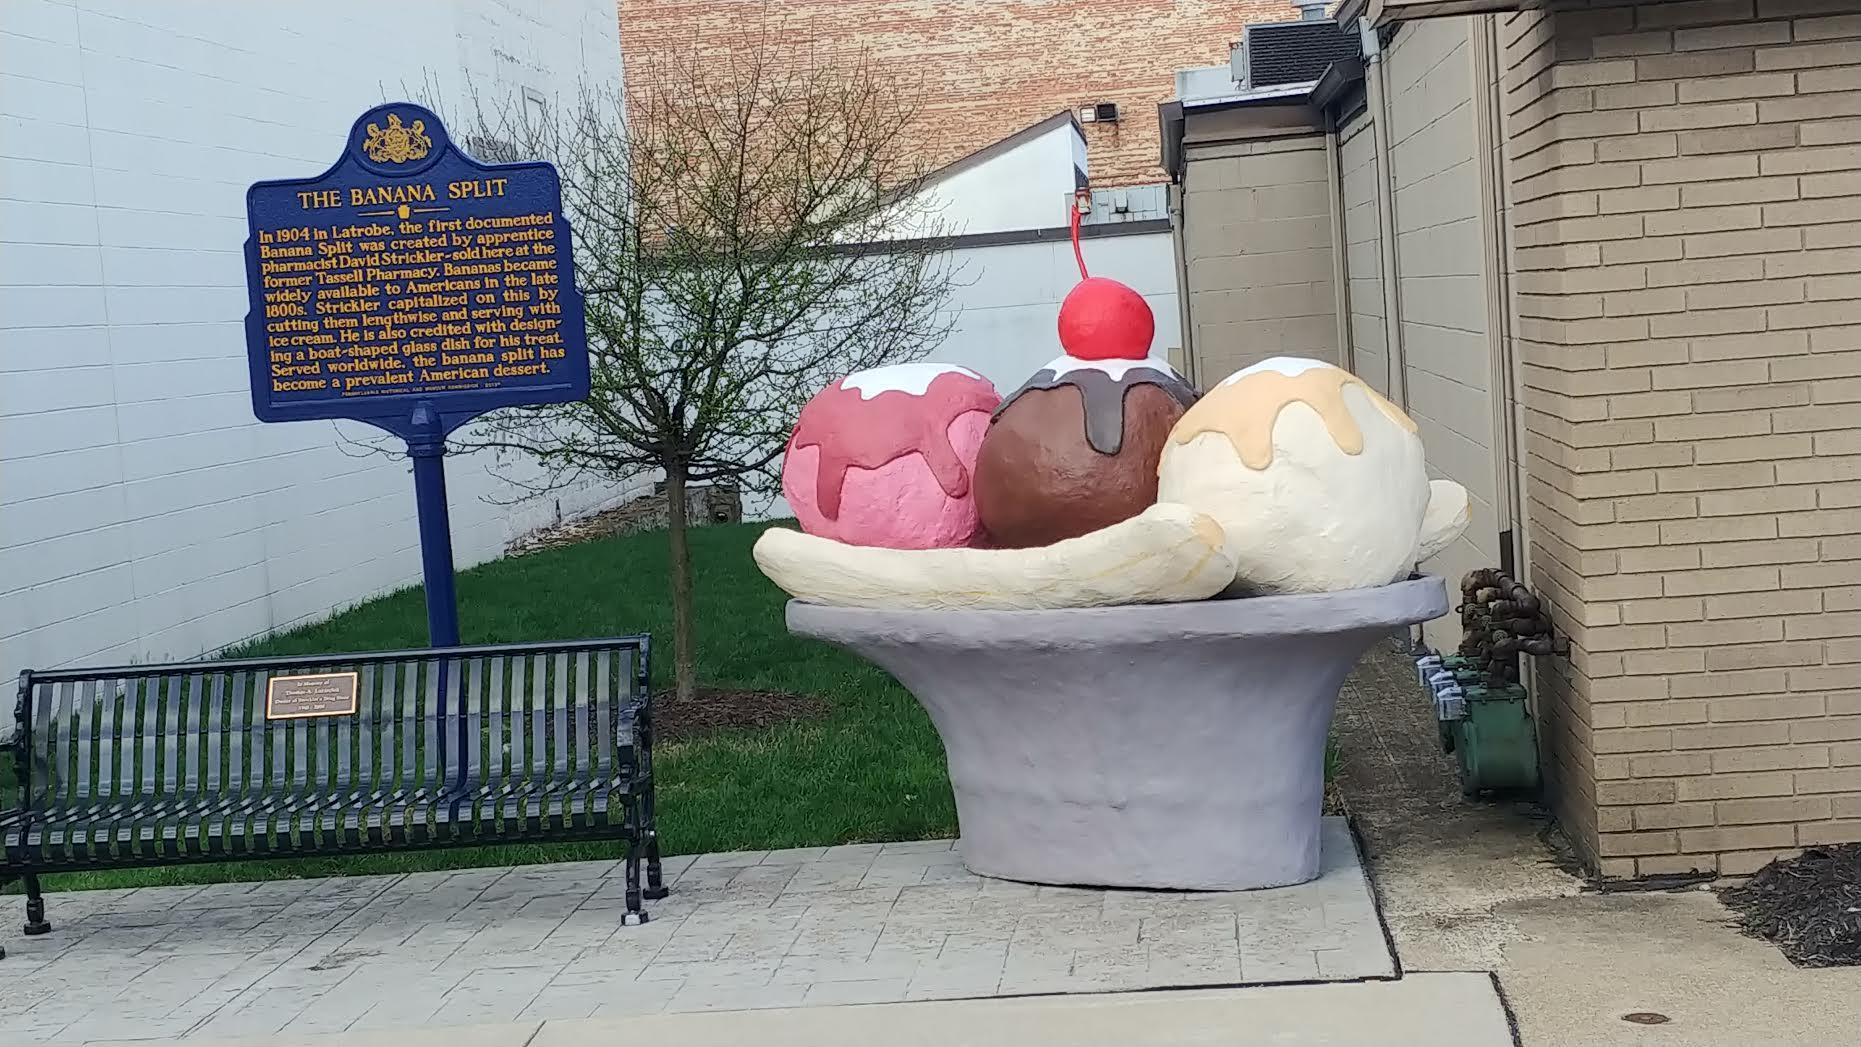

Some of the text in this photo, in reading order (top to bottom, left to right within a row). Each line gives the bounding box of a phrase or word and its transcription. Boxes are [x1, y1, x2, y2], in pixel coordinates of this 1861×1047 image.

[297, 179, 507, 209] THE BANANA SPLIT
[259, 230, 273, 244] In
[277, 227, 310, 242] 1904
[314, 228, 328, 240] in
[399, 222, 423, 234] the
[428, 219, 462, 232] first
[466, 212, 553, 229] documented
[260, 229, 554, 258] Banana Split was created by apprentice
[262, 258, 337, 275] pharmacist
[339, 252, 380, 268] David
[482, 246, 514, 258] here
[515, 245, 529, 256] at
[532, 242, 555, 254] the
[264, 259, 557, 288] former Tassell Pharmacy. Bananas became
[265, 273, 558, 303] widely available to Americans in the late
[266, 287, 558, 318] 1800s. Strickler capitalized on this by
[267, 302, 561, 332] cutting them lengthwise and serving with
[269, 318, 561, 347] ice cream. He is also credited with design-
[271, 333, 563, 364] ing a boat-shaped glass dish for his treat.
[271, 362, 320, 377] Served
[413, 354, 437, 368] the
[442, 352, 494, 366] banana
[501, 348, 534, 363] split
[540, 347, 565, 359] has
[273, 362, 550, 391] become a prevalent American dessert.
